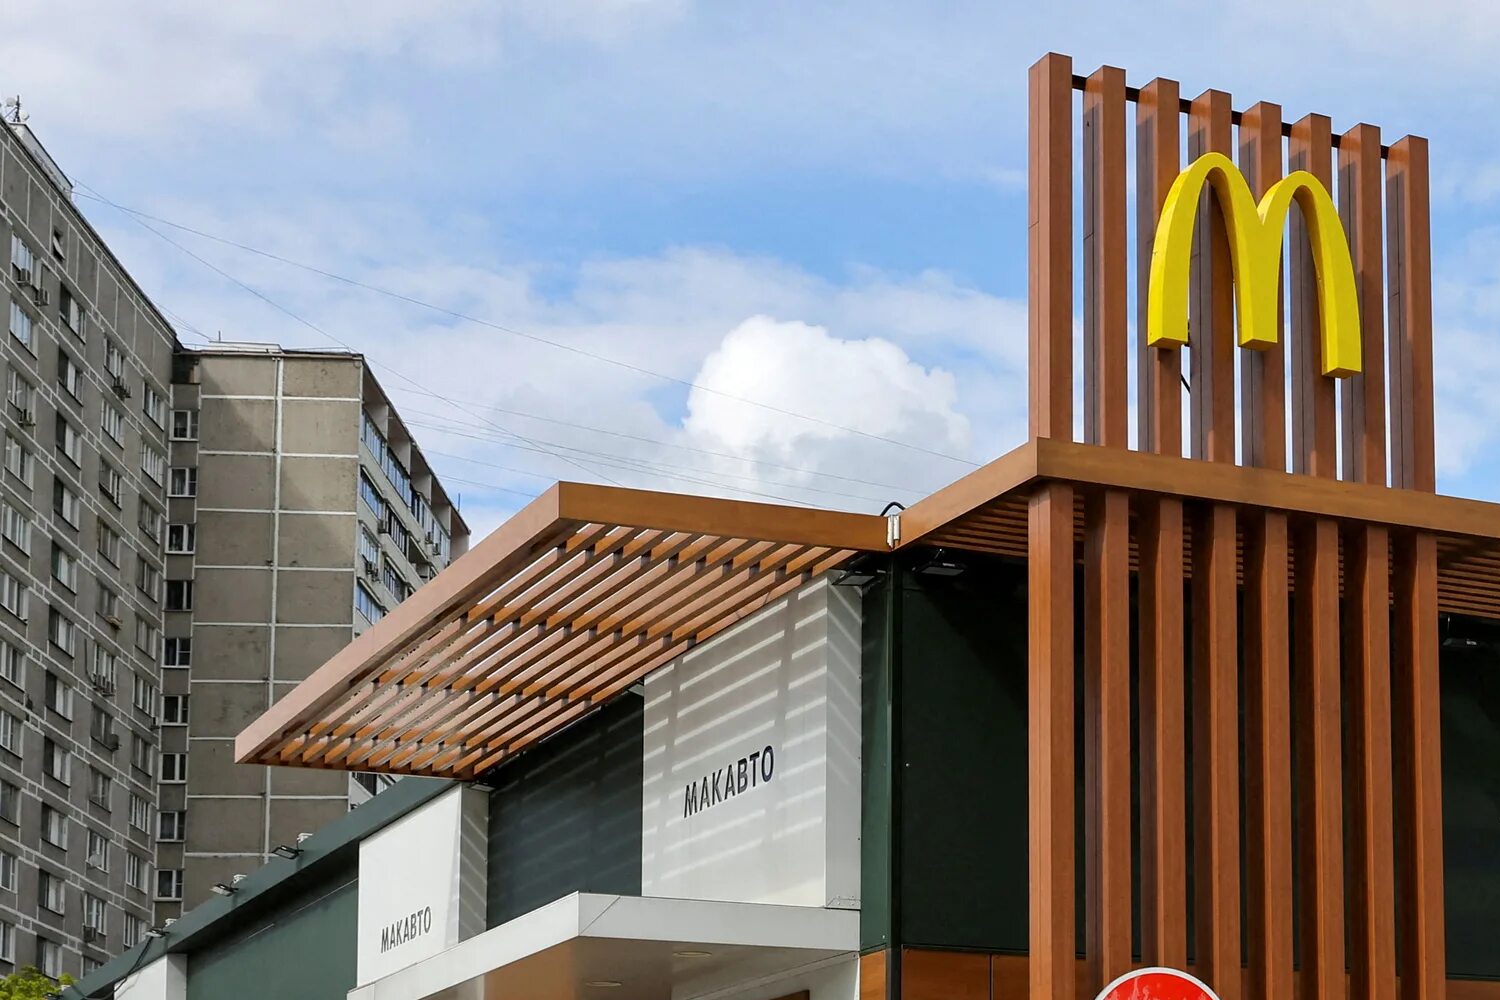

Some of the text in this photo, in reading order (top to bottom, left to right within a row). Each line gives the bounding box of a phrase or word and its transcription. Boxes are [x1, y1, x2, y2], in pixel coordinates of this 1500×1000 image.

[1147, 151, 1362, 379] M
[683, 745, 775, 819] МАКАВТО
[380, 905, 432, 954] МАКАВТО
